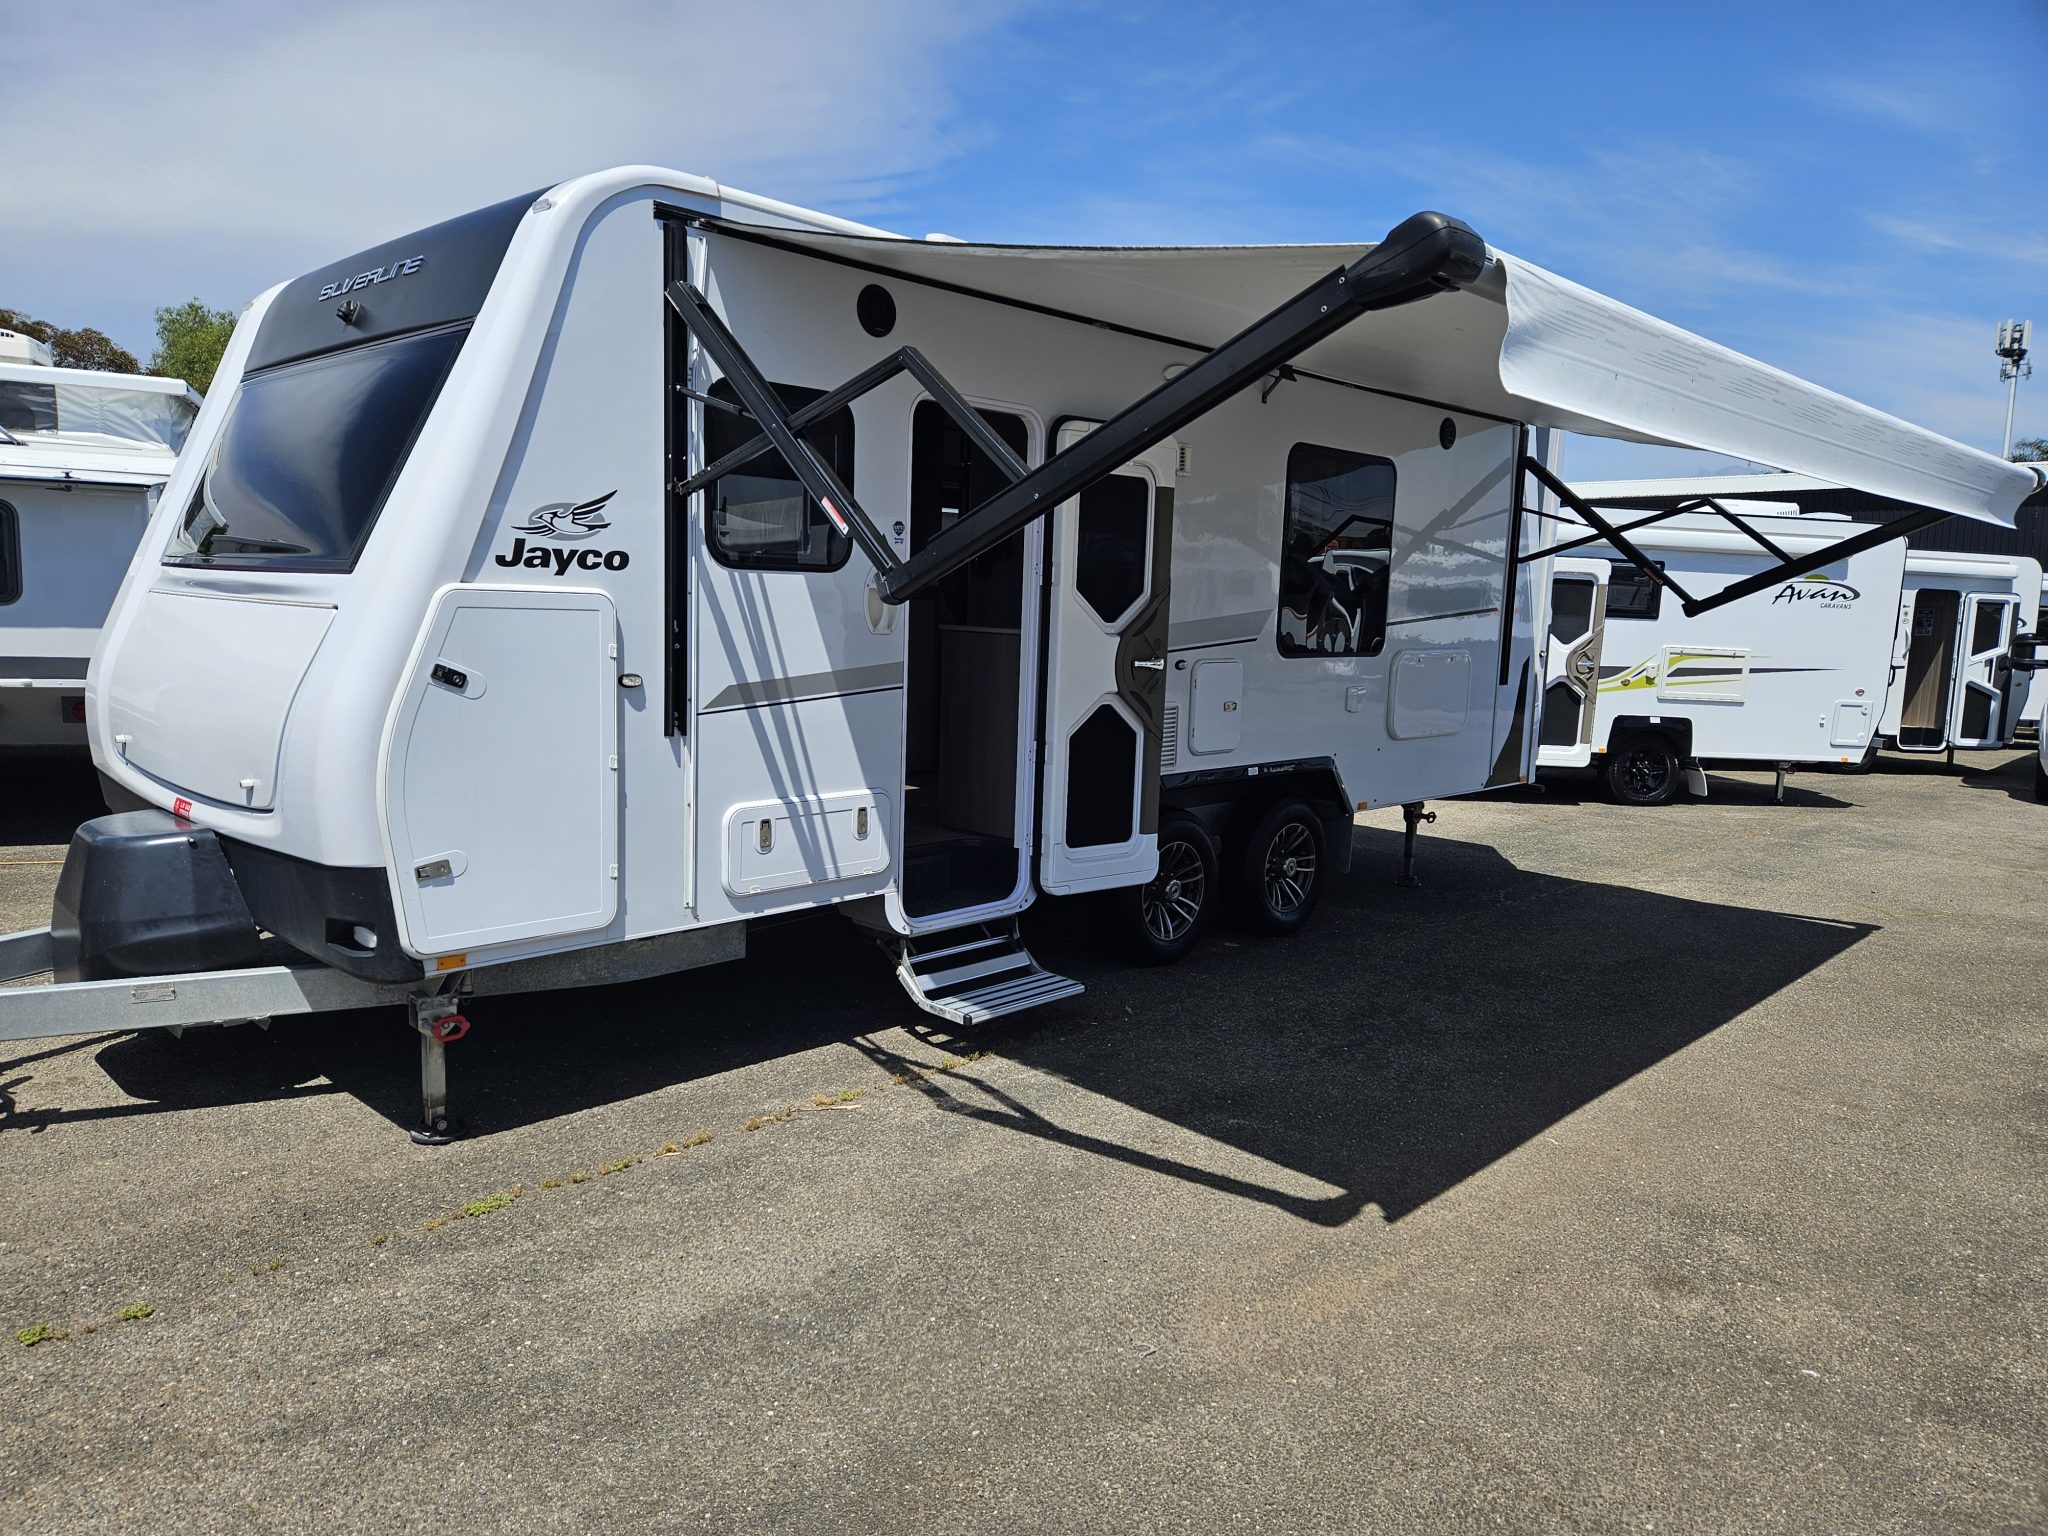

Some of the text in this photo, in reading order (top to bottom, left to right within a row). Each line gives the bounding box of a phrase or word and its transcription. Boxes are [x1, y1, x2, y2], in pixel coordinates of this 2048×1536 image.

[318, 255, 425, 302] SILVERLINE
[495, 537, 630, 576] Jayco
[1772, 583, 1853, 605] Avan
[1820, 602, 1852, 610] CARAVANS
